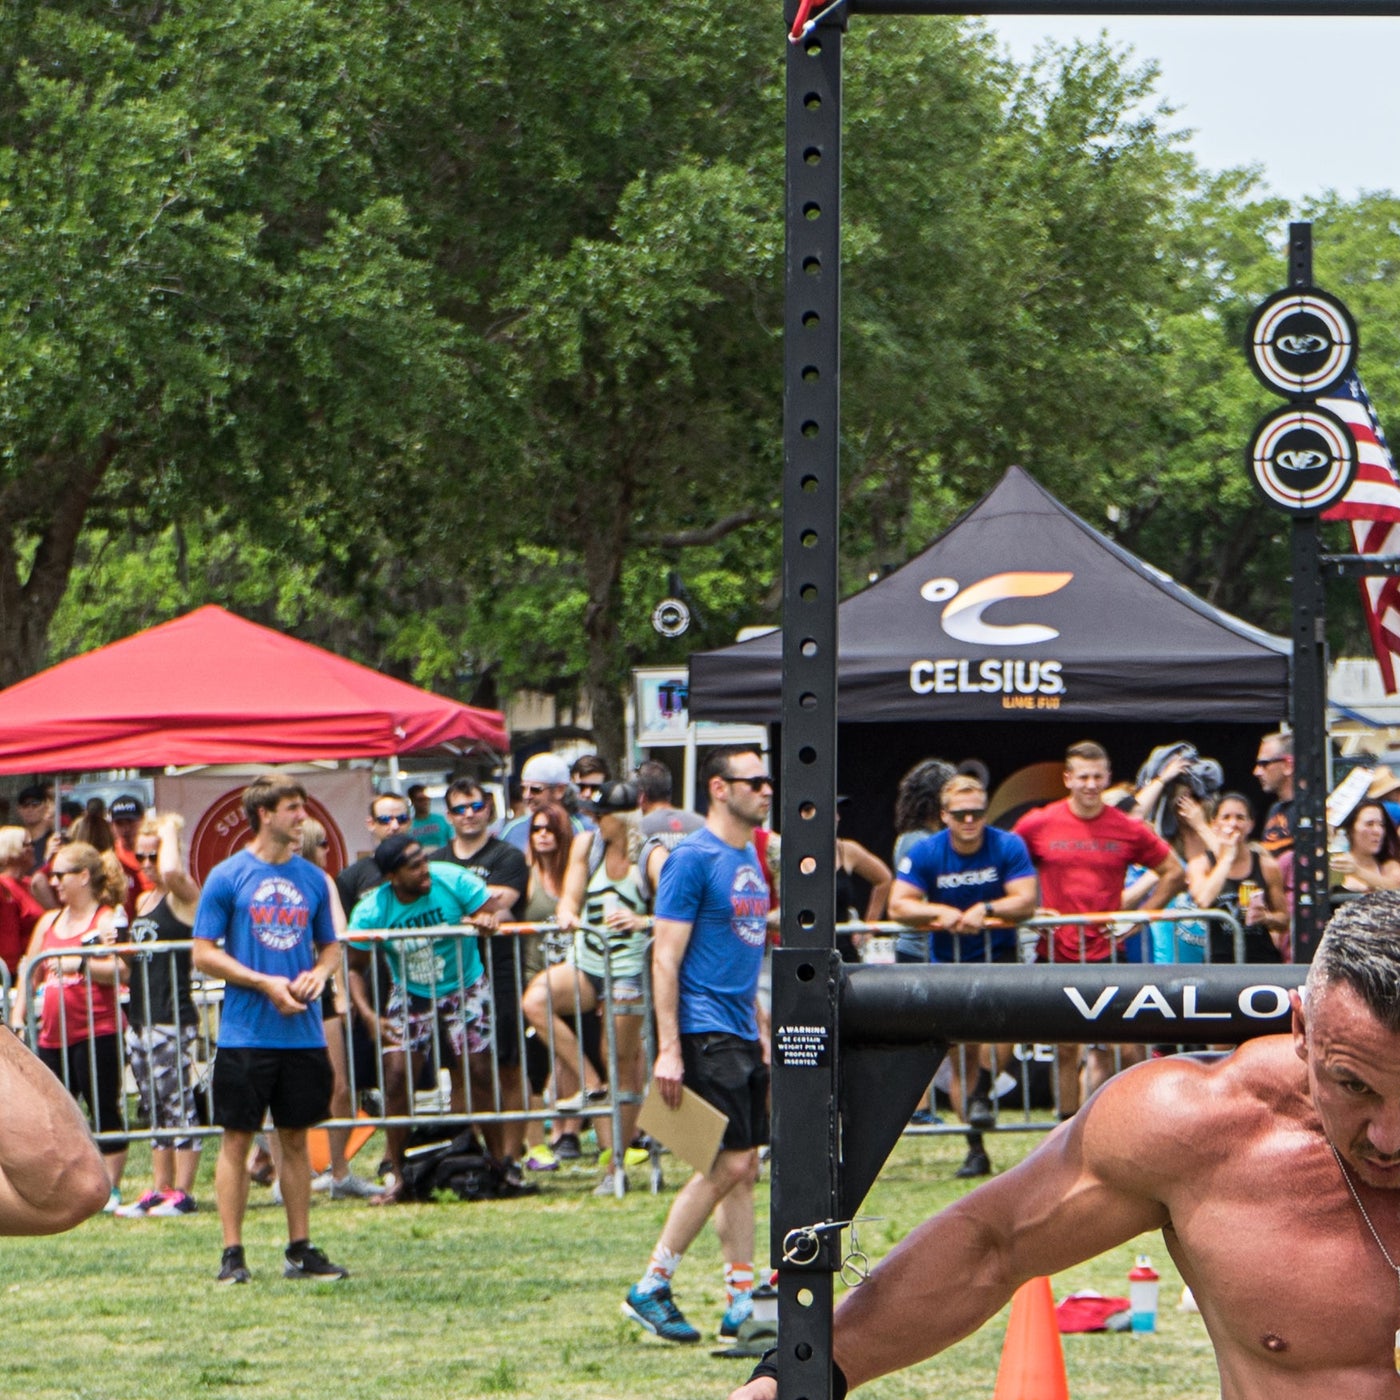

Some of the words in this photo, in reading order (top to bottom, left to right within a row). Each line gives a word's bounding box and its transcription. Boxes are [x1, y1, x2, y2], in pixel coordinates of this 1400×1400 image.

[910, 658, 1065, 695] CELSIUS
[936, 866, 999, 889] ROGUE
[1063, 984, 1305, 1021] VALO
[786, 1025, 826, 1034] WARNING
